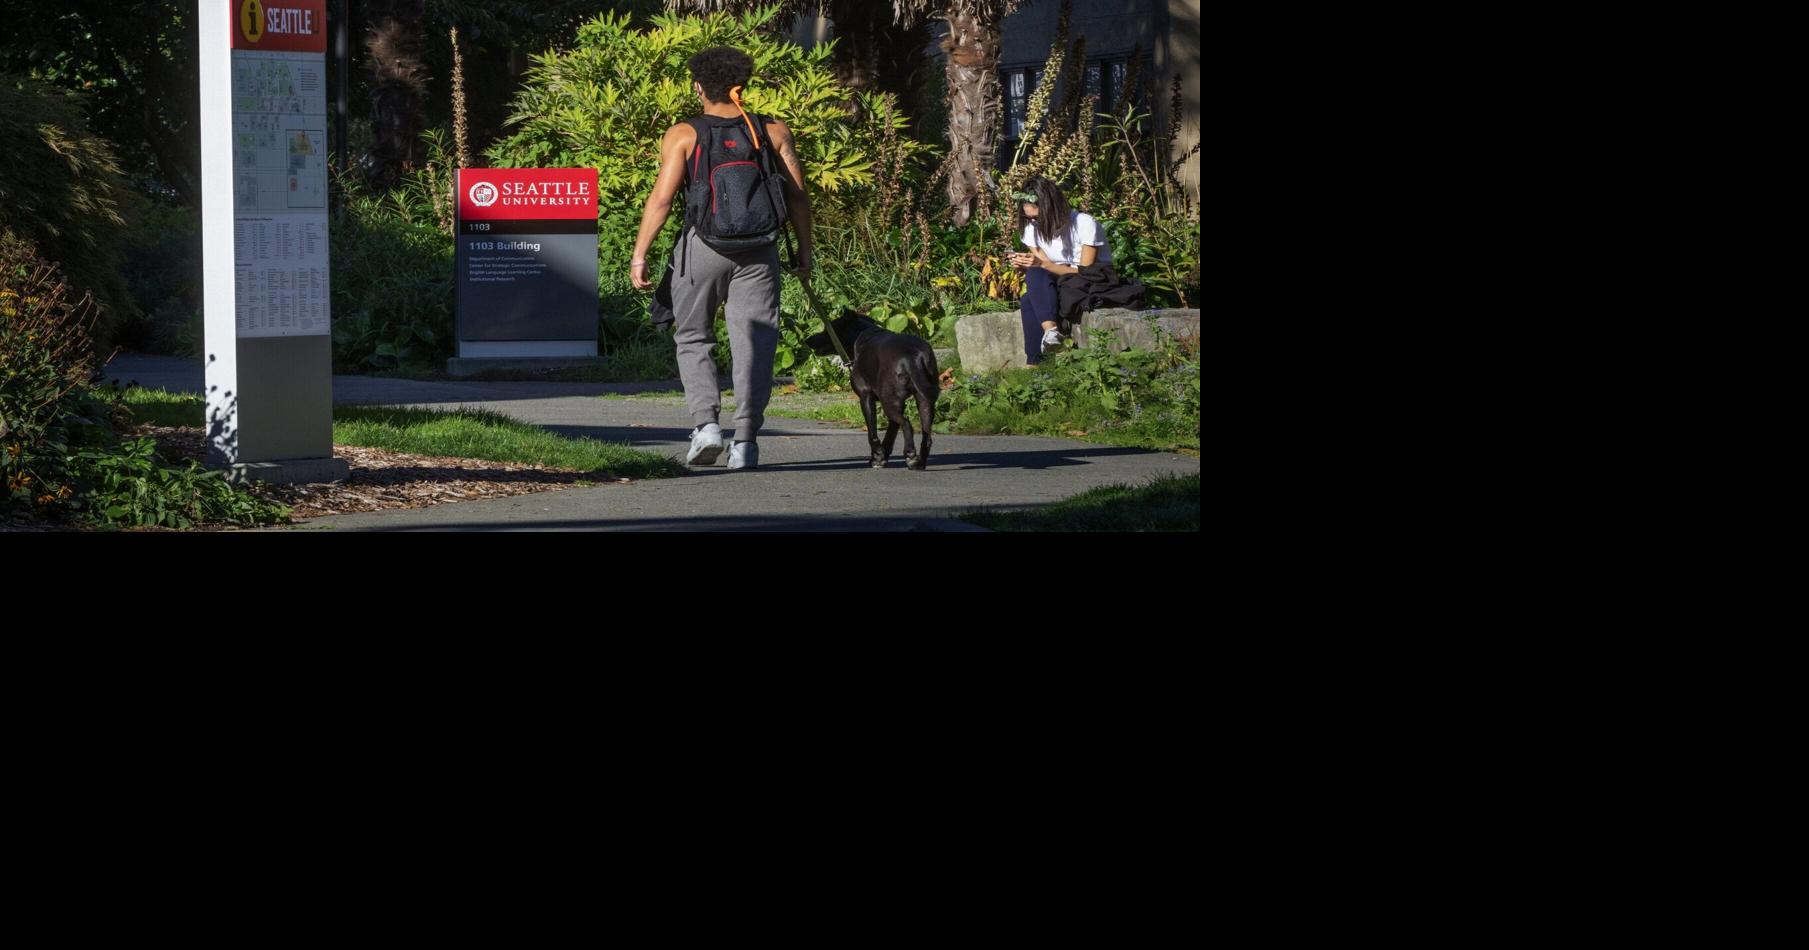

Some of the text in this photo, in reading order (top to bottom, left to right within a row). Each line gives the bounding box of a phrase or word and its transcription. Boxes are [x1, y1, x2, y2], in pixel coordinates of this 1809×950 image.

[502, 182, 590, 195] SEATTLE
[469, 223, 491, 231] 1103
[469, 241, 541, 252] 1103 Building
